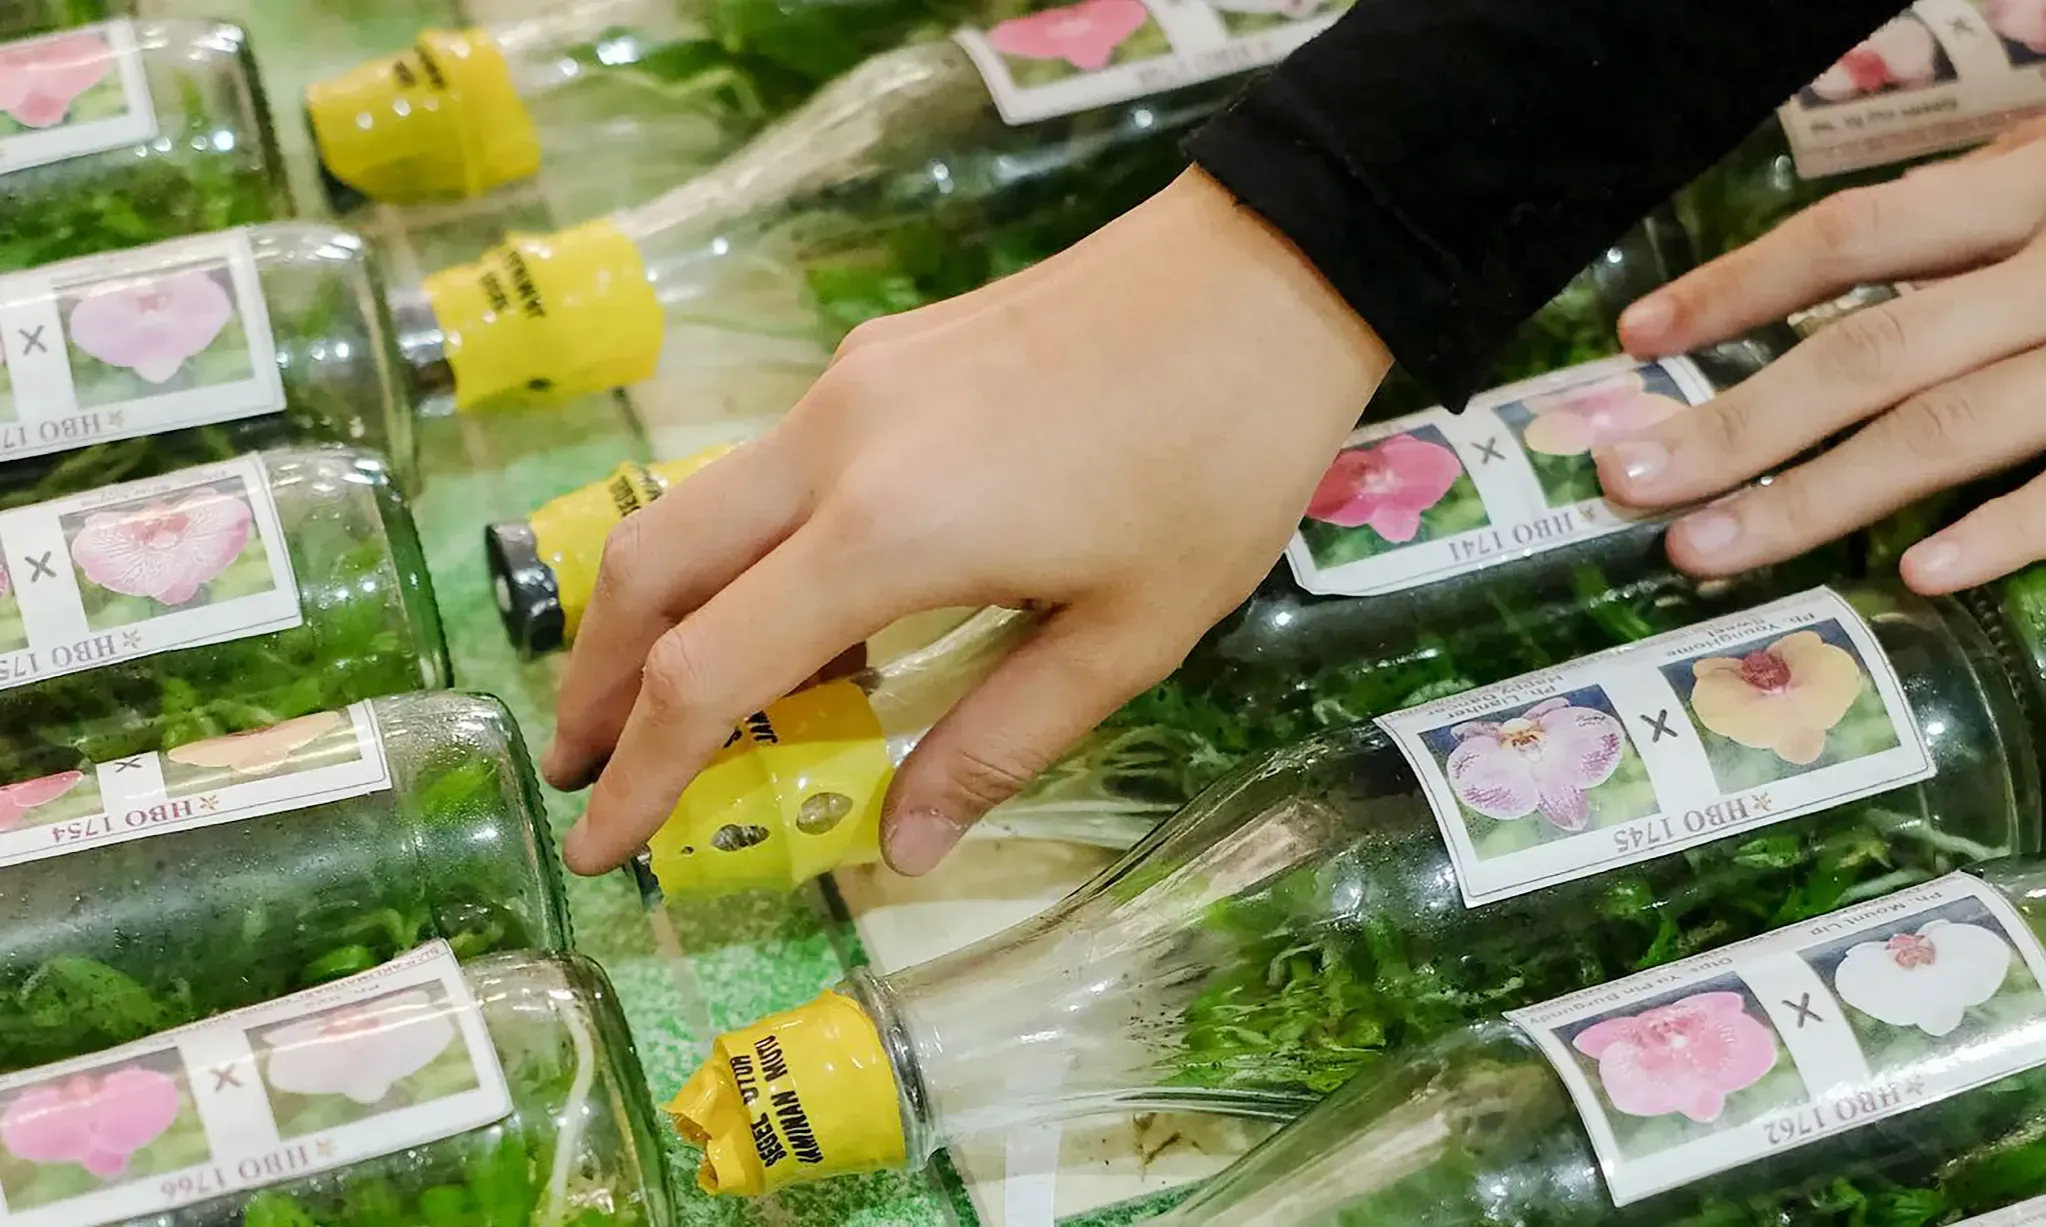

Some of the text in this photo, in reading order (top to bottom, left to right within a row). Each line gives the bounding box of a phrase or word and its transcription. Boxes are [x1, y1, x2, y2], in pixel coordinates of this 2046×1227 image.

[39, 413, 101, 441] HBO
[1447, 511, 1576, 562] HBO 1741
[51, 635, 116, 668] HBO
[52, 800, 192, 843] HBO 1754
[1613, 797, 1749, 852] HBO 1745
[754, 1035, 824, 1164] JAMINAN MUTU
[1763, 1082, 1900, 1146] HBO 1762
[750, 1112, 787, 1168] SEGEL
[160, 1145, 309, 1197] HBO 1766
